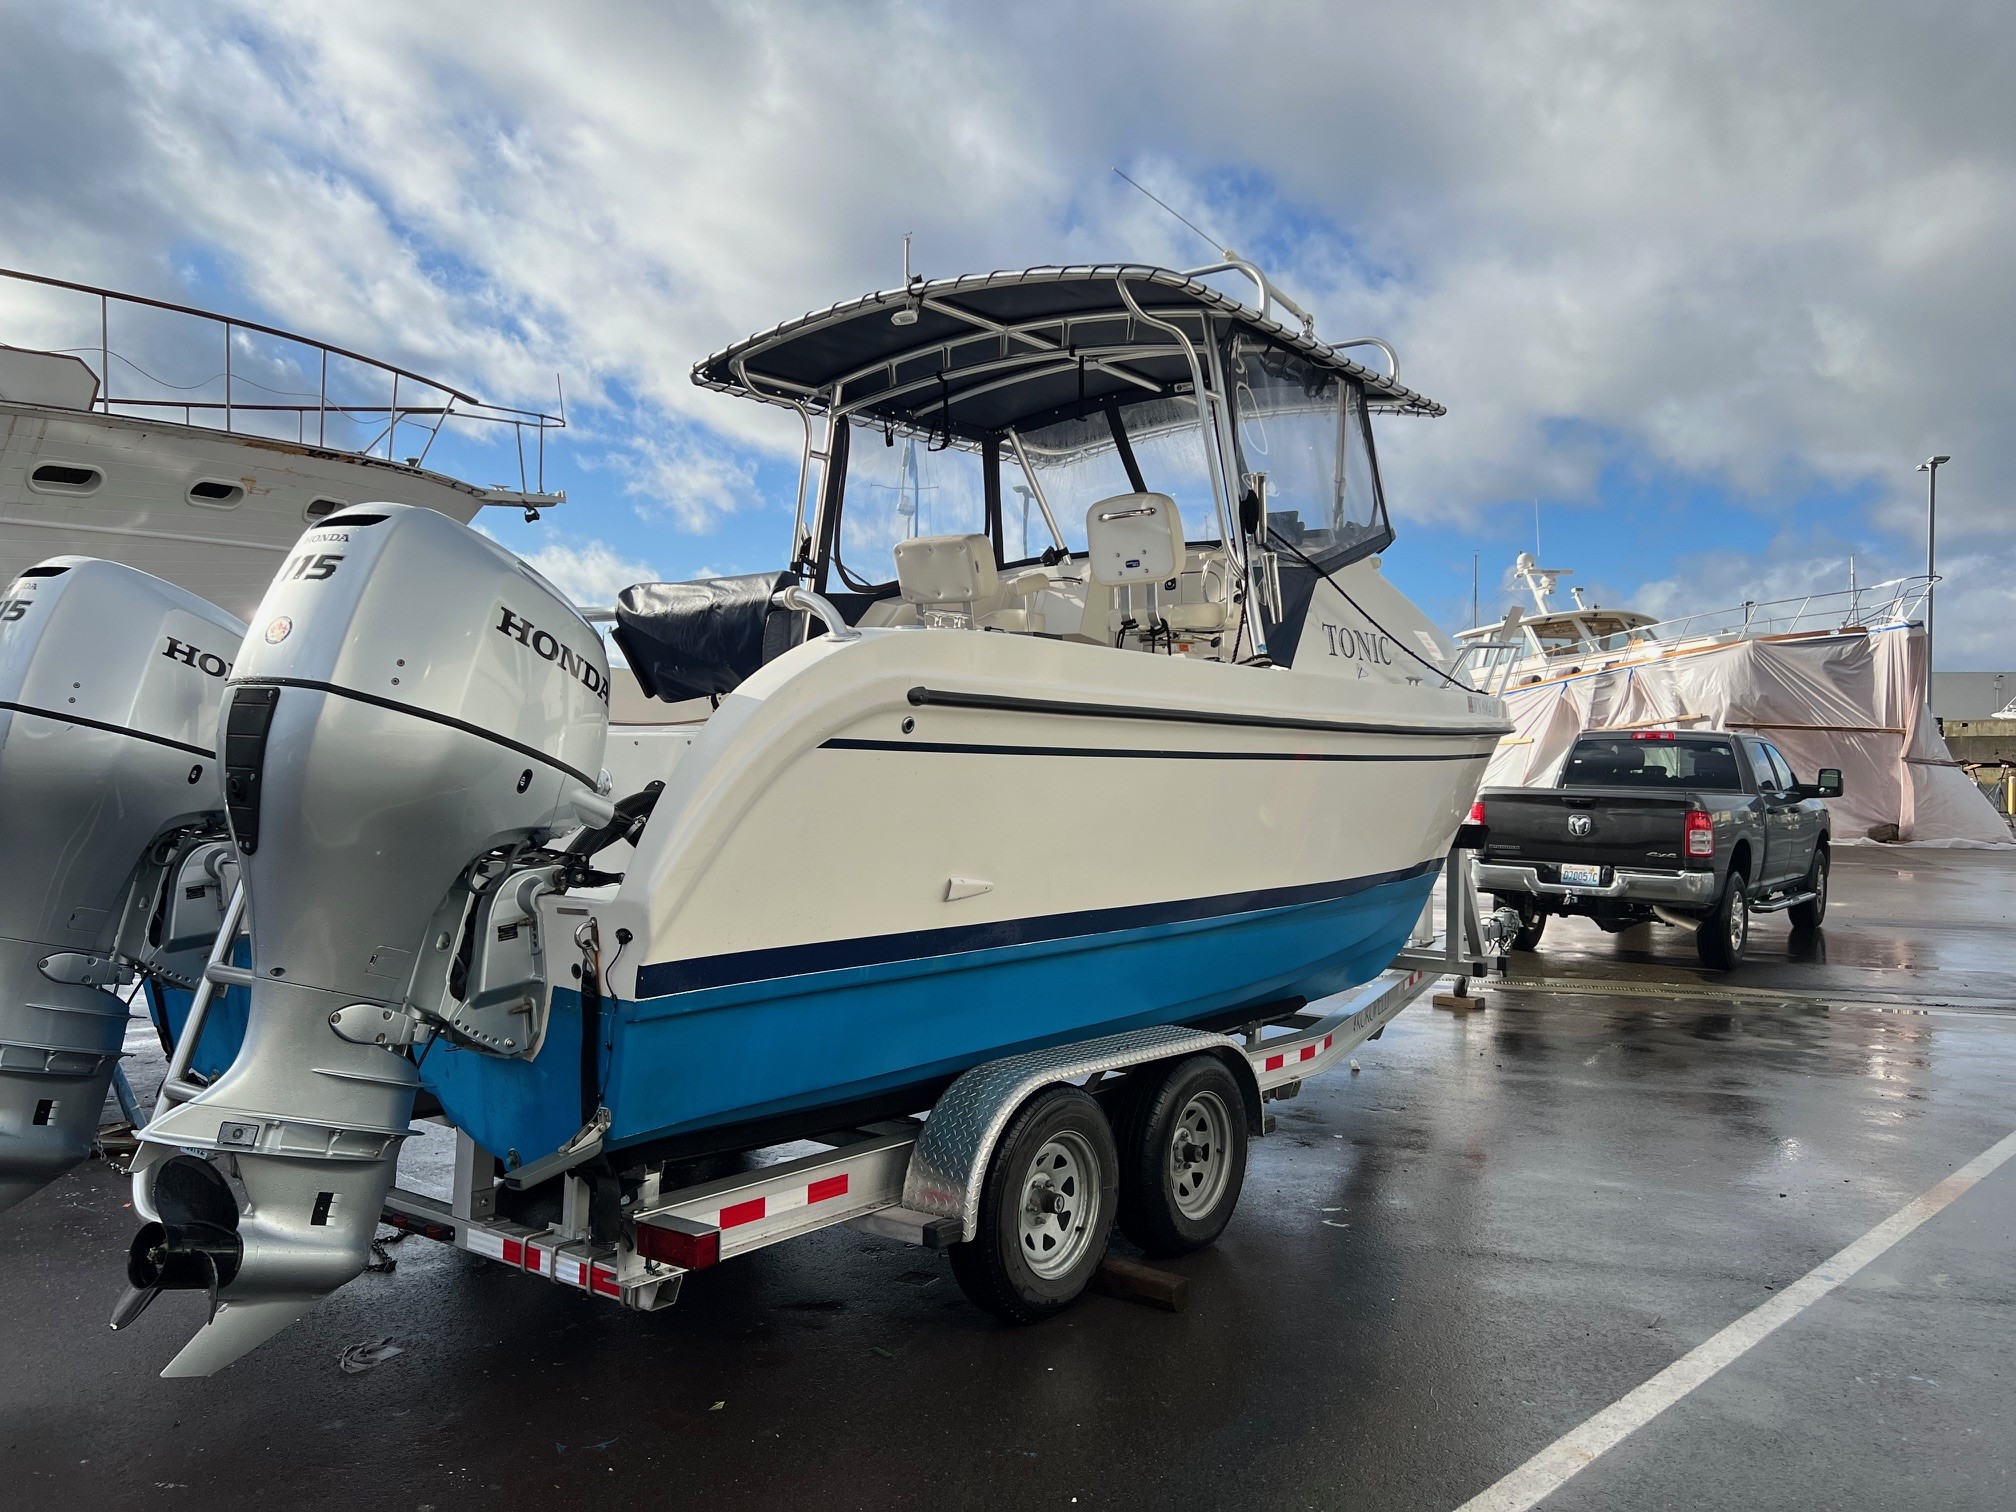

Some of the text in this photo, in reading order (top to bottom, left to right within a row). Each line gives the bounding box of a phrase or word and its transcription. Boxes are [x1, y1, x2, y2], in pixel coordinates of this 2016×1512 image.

[304, 533, 349, 543] HONDA
[281, 554, 348, 581] 115
[0, 600, 34, 621] 15
[162, 636, 234, 681] HO
[496, 606, 609, 708] HONDA
[1322, 622, 1392, 665] TONIC
